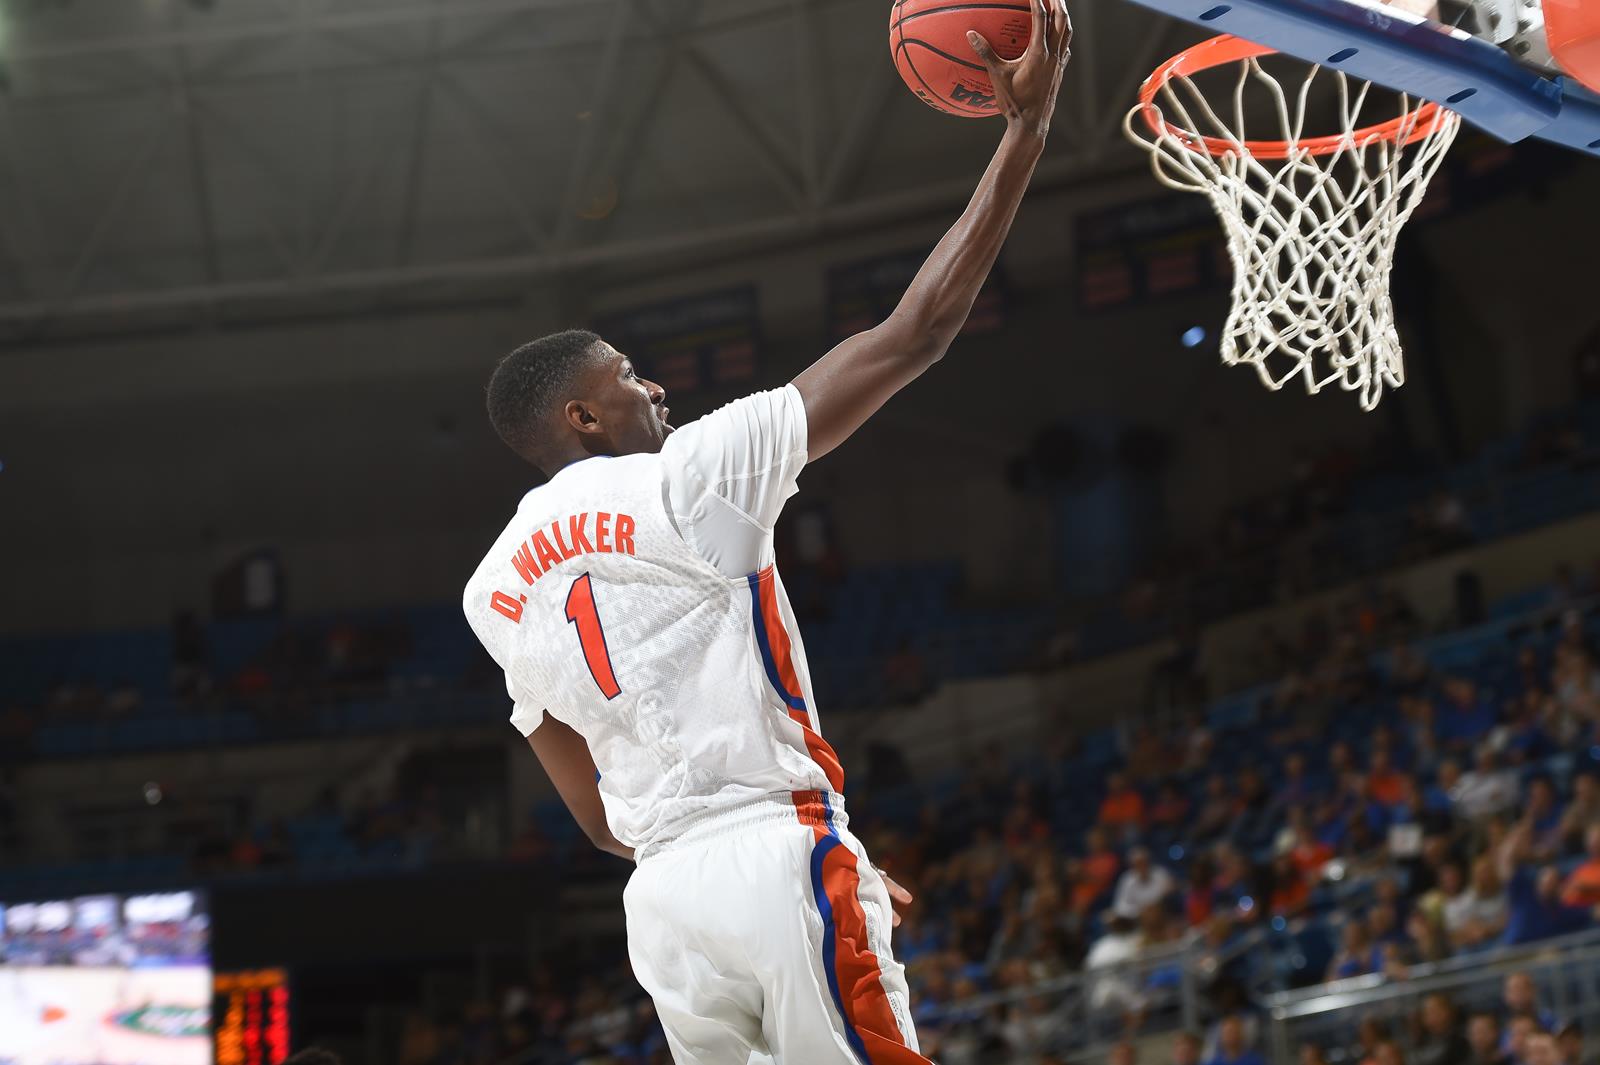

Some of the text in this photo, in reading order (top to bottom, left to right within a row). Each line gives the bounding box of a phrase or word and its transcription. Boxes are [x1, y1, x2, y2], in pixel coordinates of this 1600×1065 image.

[490, 511, 636, 624] D. WALKER
[564, 571, 622, 701] 1
